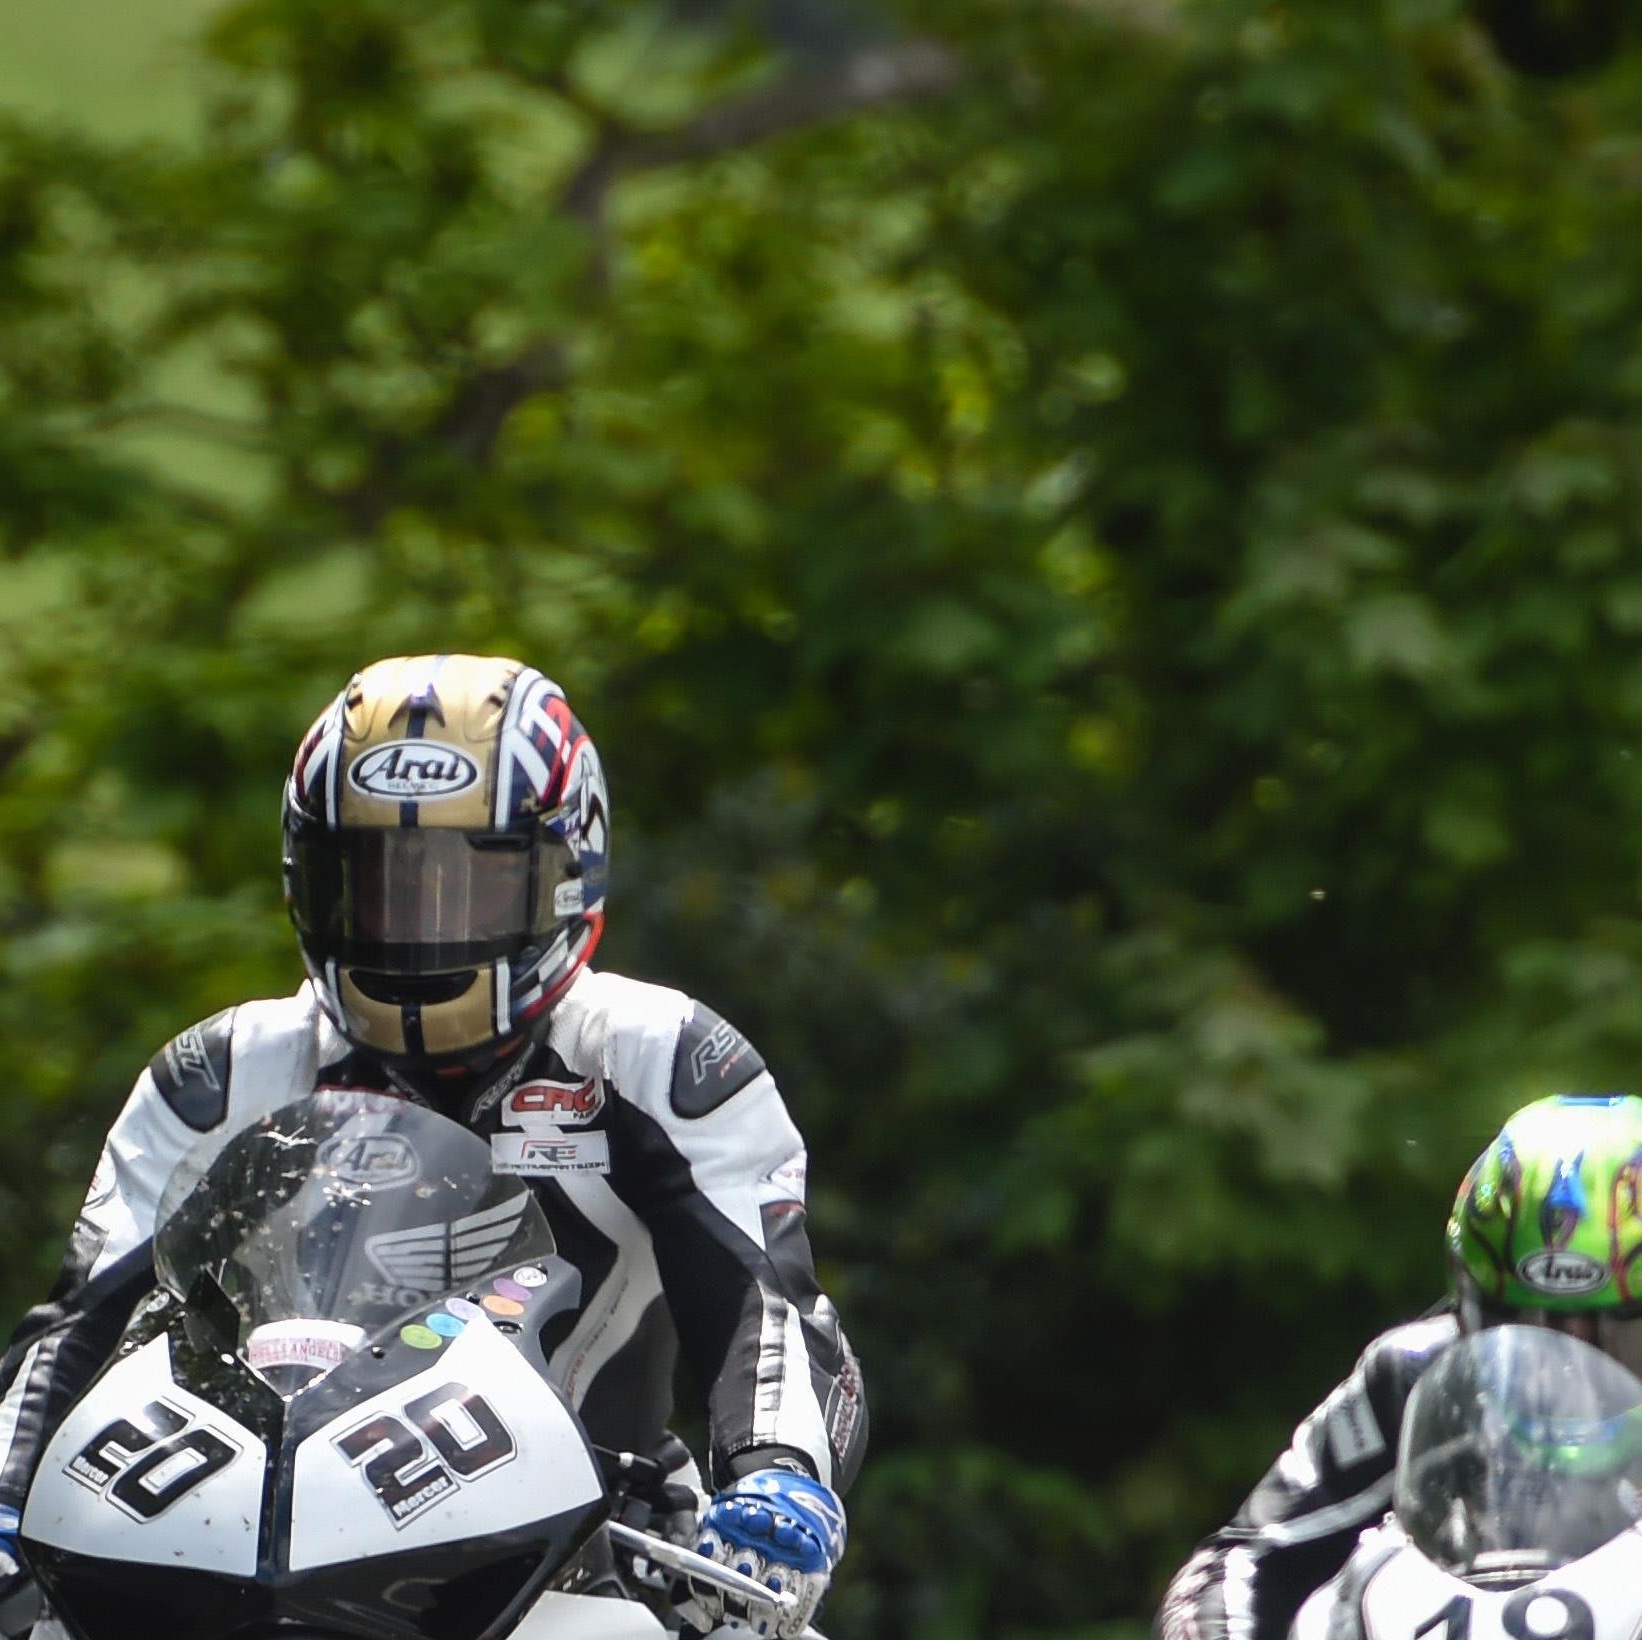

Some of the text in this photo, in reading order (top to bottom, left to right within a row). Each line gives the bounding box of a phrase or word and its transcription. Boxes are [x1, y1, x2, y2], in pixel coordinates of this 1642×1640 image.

[357, 748, 460, 781] Arai
[691, 1019, 743, 1085] RS
[64, 1397, 242, 1522] 20
[333, 1382, 516, 1526] 20
[392, 1476, 449, 1517] Mercer
